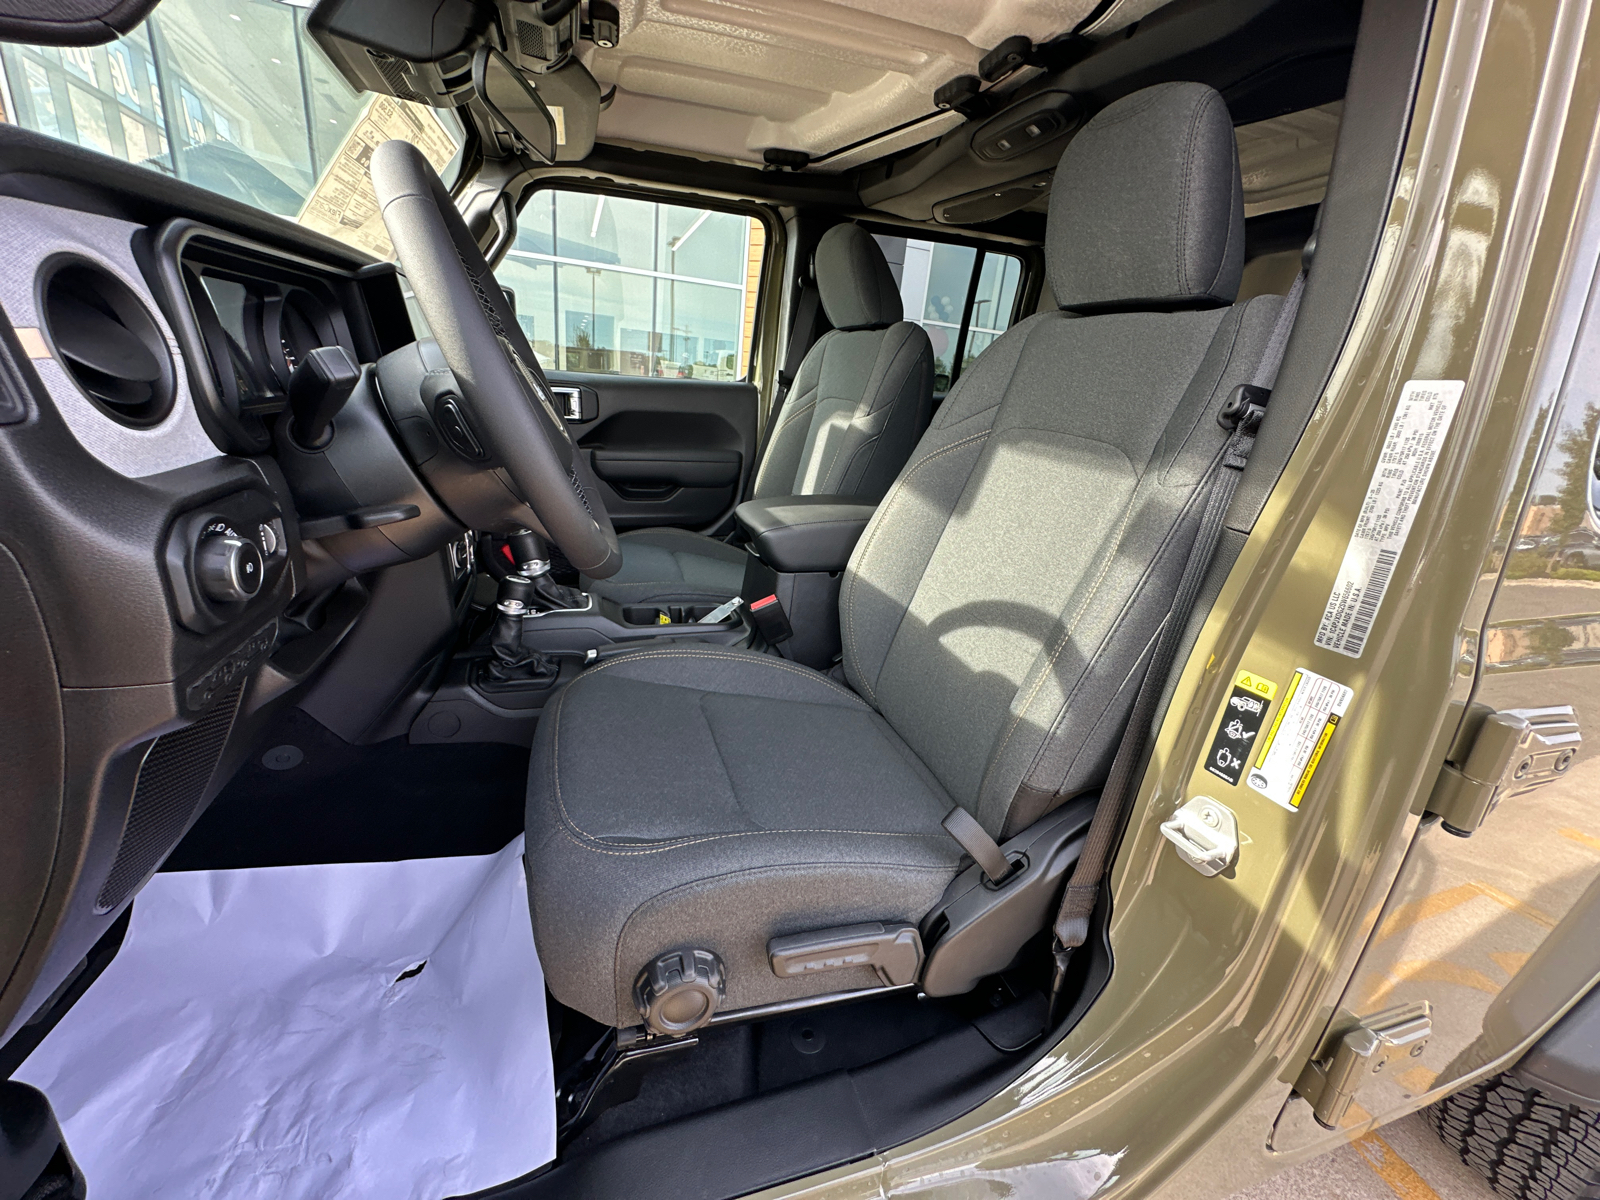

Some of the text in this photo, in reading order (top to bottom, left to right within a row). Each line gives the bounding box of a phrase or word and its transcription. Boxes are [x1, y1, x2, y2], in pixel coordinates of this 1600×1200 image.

[1331, 592, 1341, 602] LLC
[1328, 602, 1337, 610] US
[1324, 610, 1334, 621] FCA
[1333, 628, 1347, 650] VEHICLE
[1341, 612, 1353, 628] MADE
[1317, 632, 1327, 644] MFD
